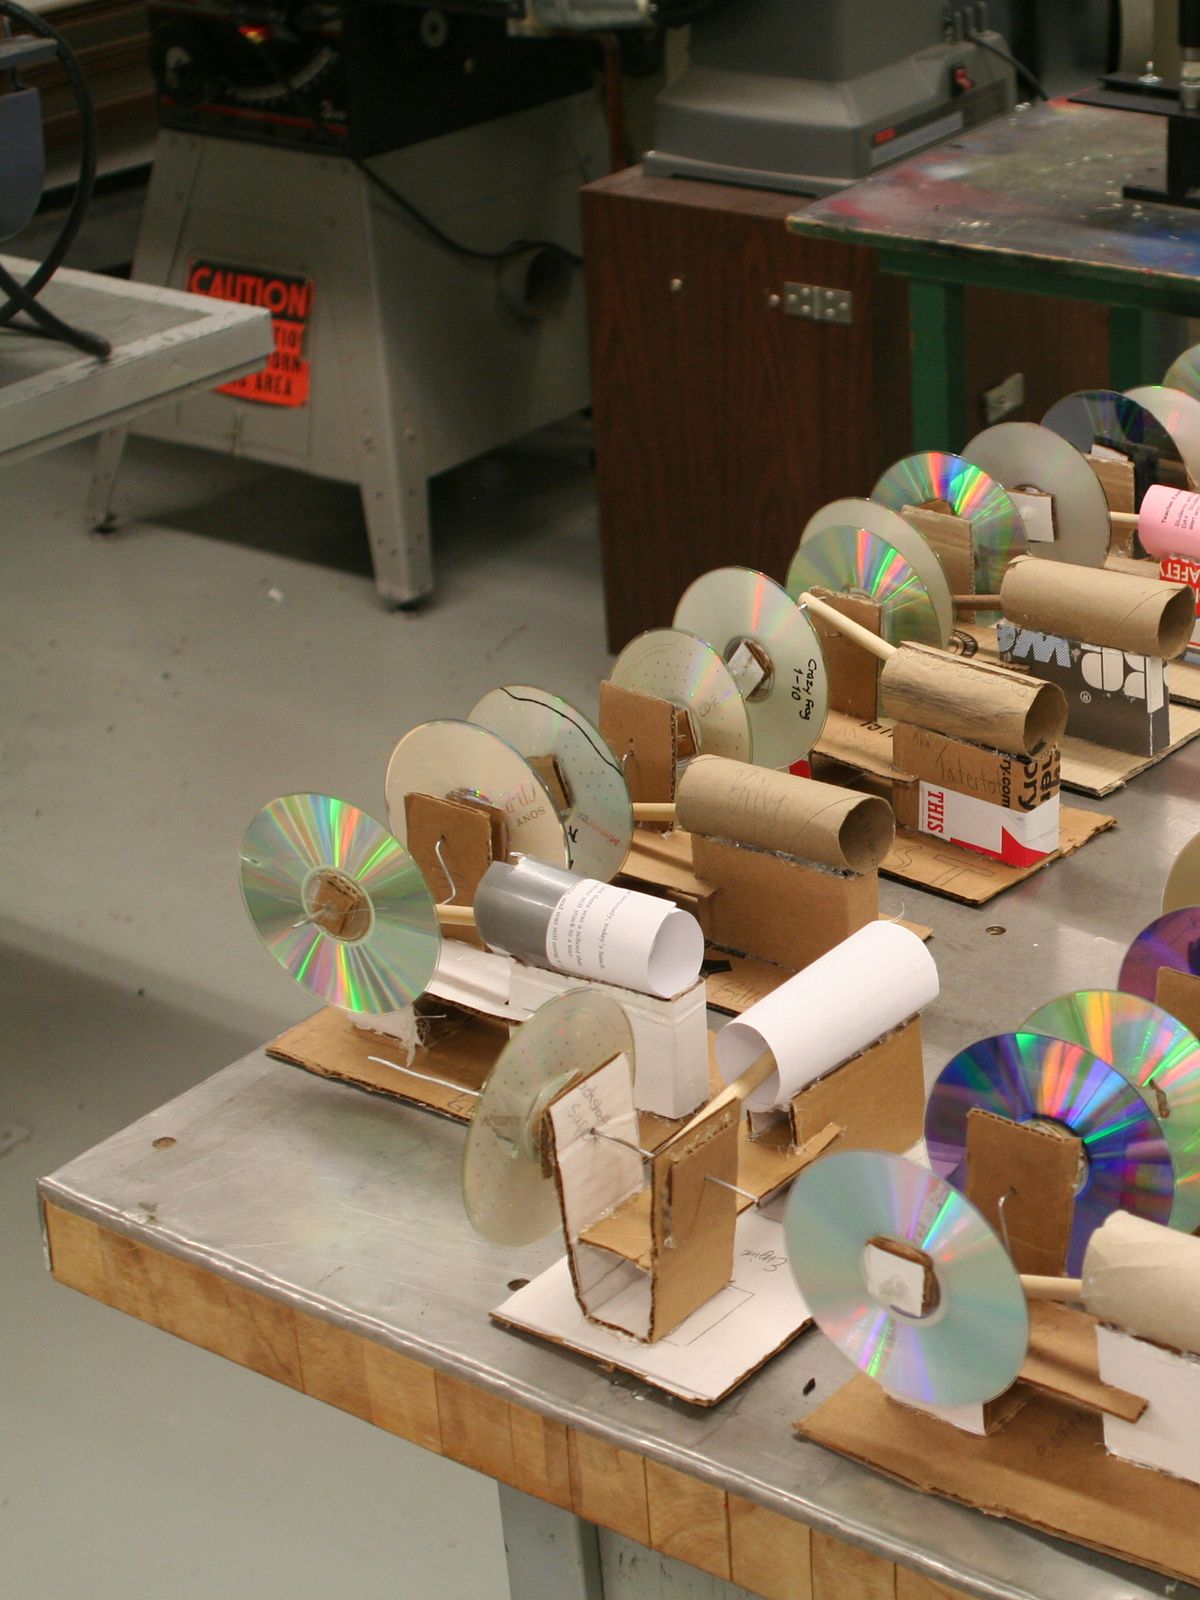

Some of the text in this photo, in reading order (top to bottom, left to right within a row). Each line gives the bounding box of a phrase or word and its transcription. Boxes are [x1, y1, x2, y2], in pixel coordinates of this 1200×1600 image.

[191, 266, 307, 319] CAUTION
[254, 372, 292, 396] AREA
[791, 668, 804, 701] 1-10
[798, 658, 817, 720] Crazy Frog
[514, 806, 546, 827] SONY
[927, 789, 945, 834] THIS
[569, 909, 579, 929] stuck
[597, 923, 609, 950] today's
